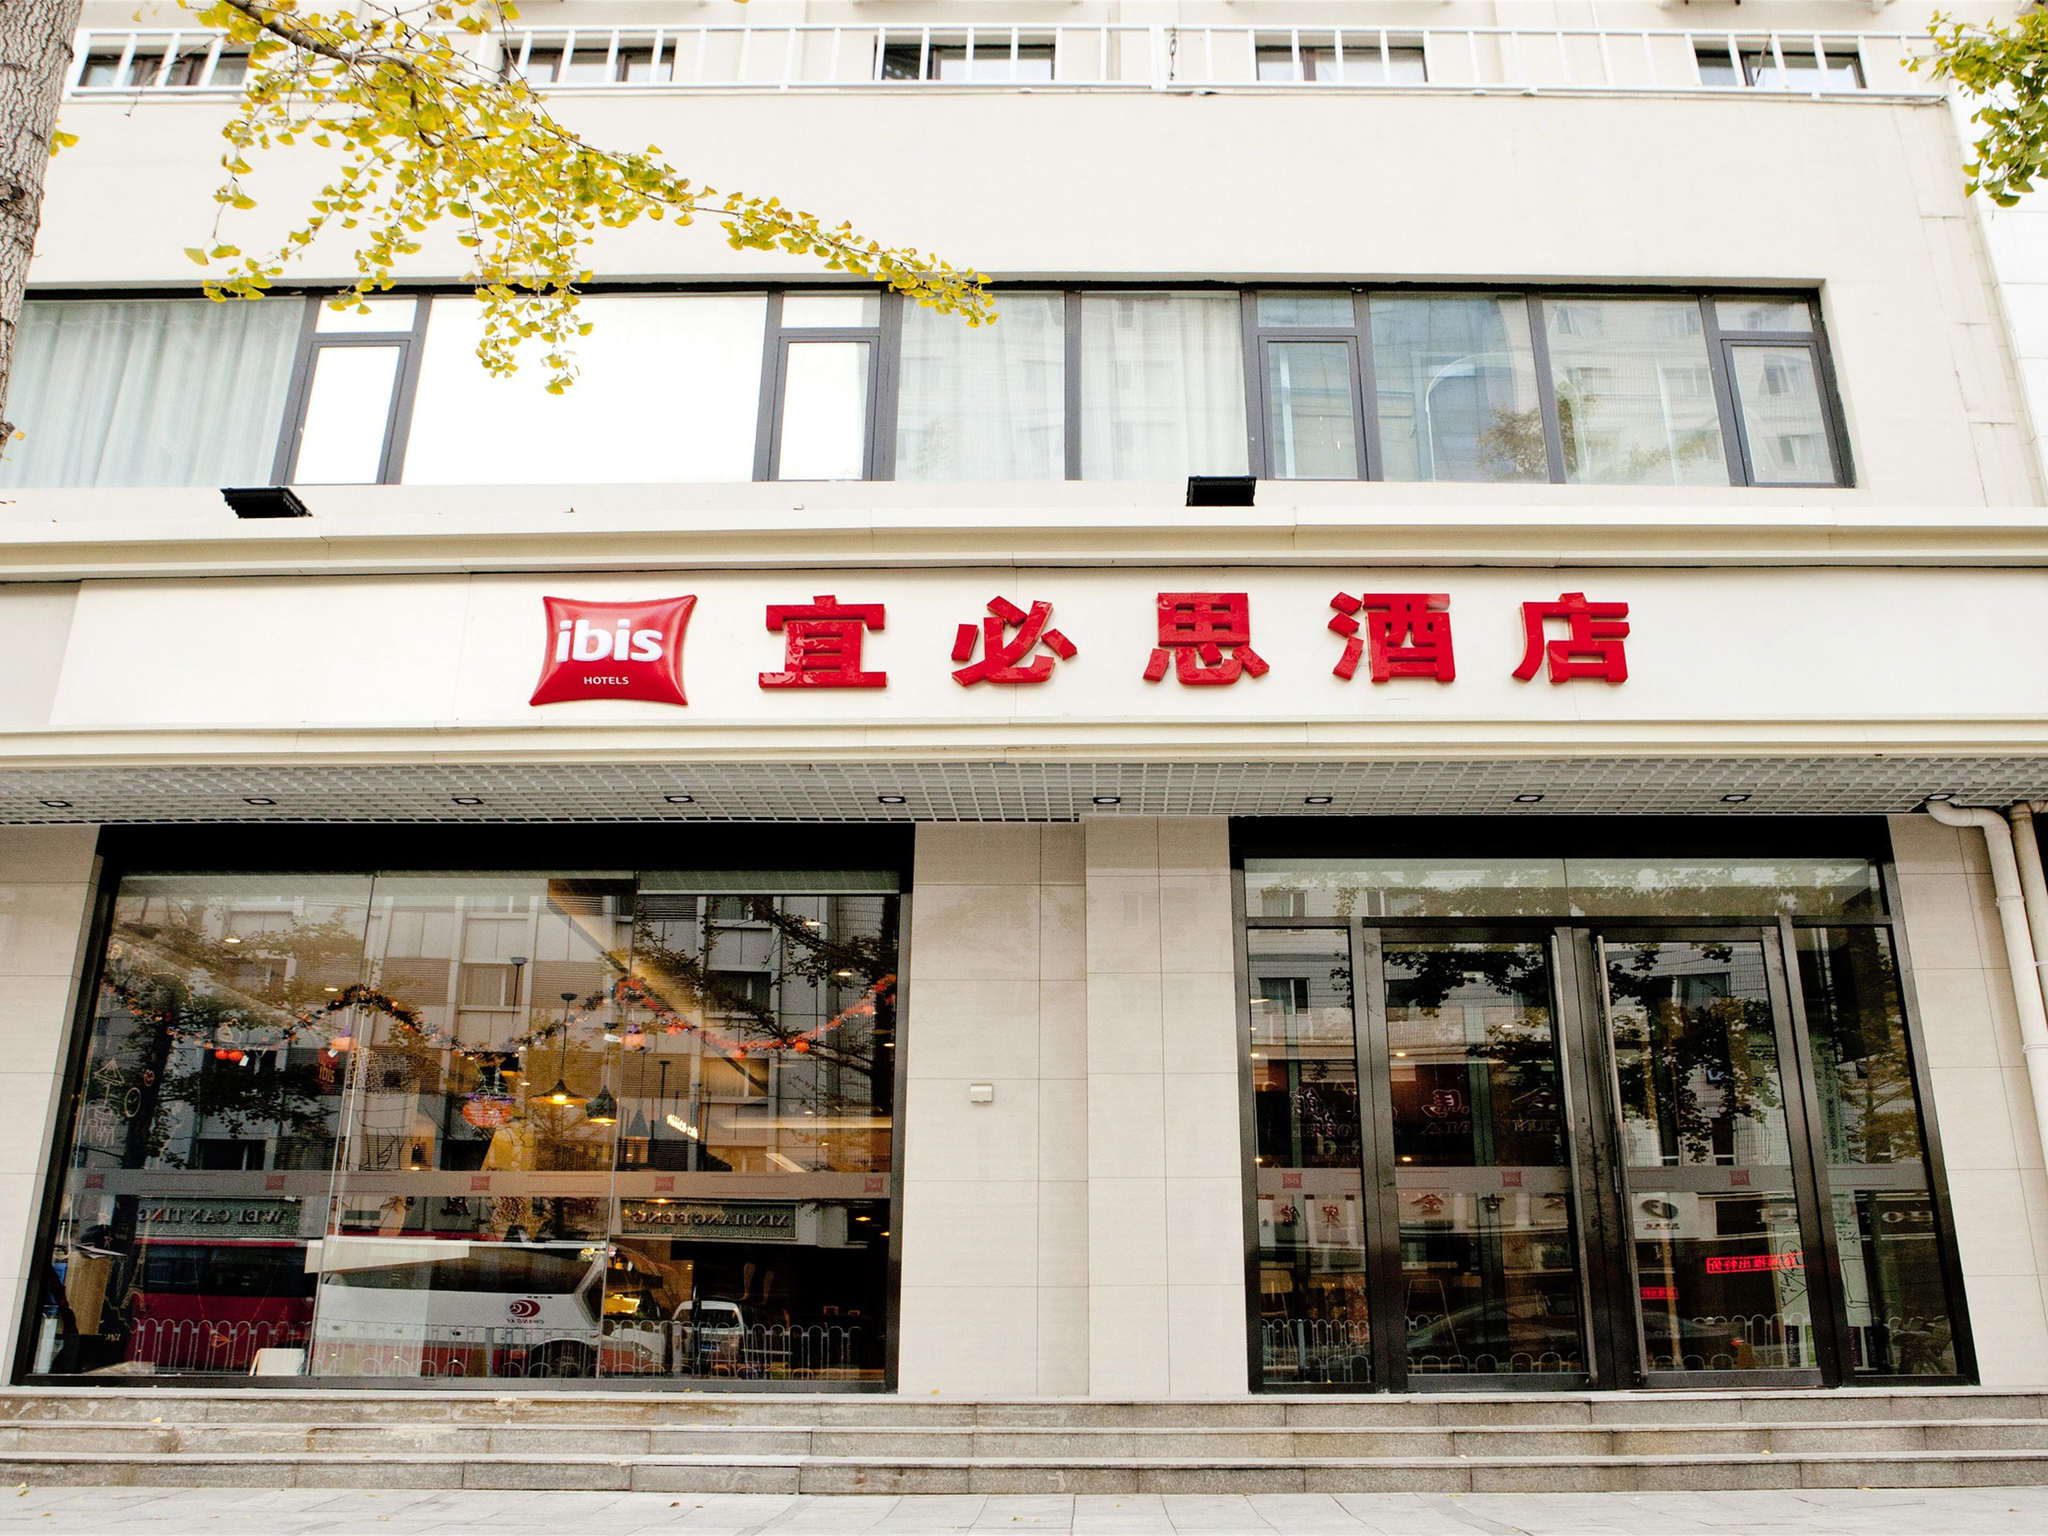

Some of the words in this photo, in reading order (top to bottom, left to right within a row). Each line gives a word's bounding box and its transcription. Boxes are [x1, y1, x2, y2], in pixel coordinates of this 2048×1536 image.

[555, 618, 664, 663] ibis
[758, 592, 1630, 690] 宜必思酒店
[583, 676, 630, 685] HOTELS
